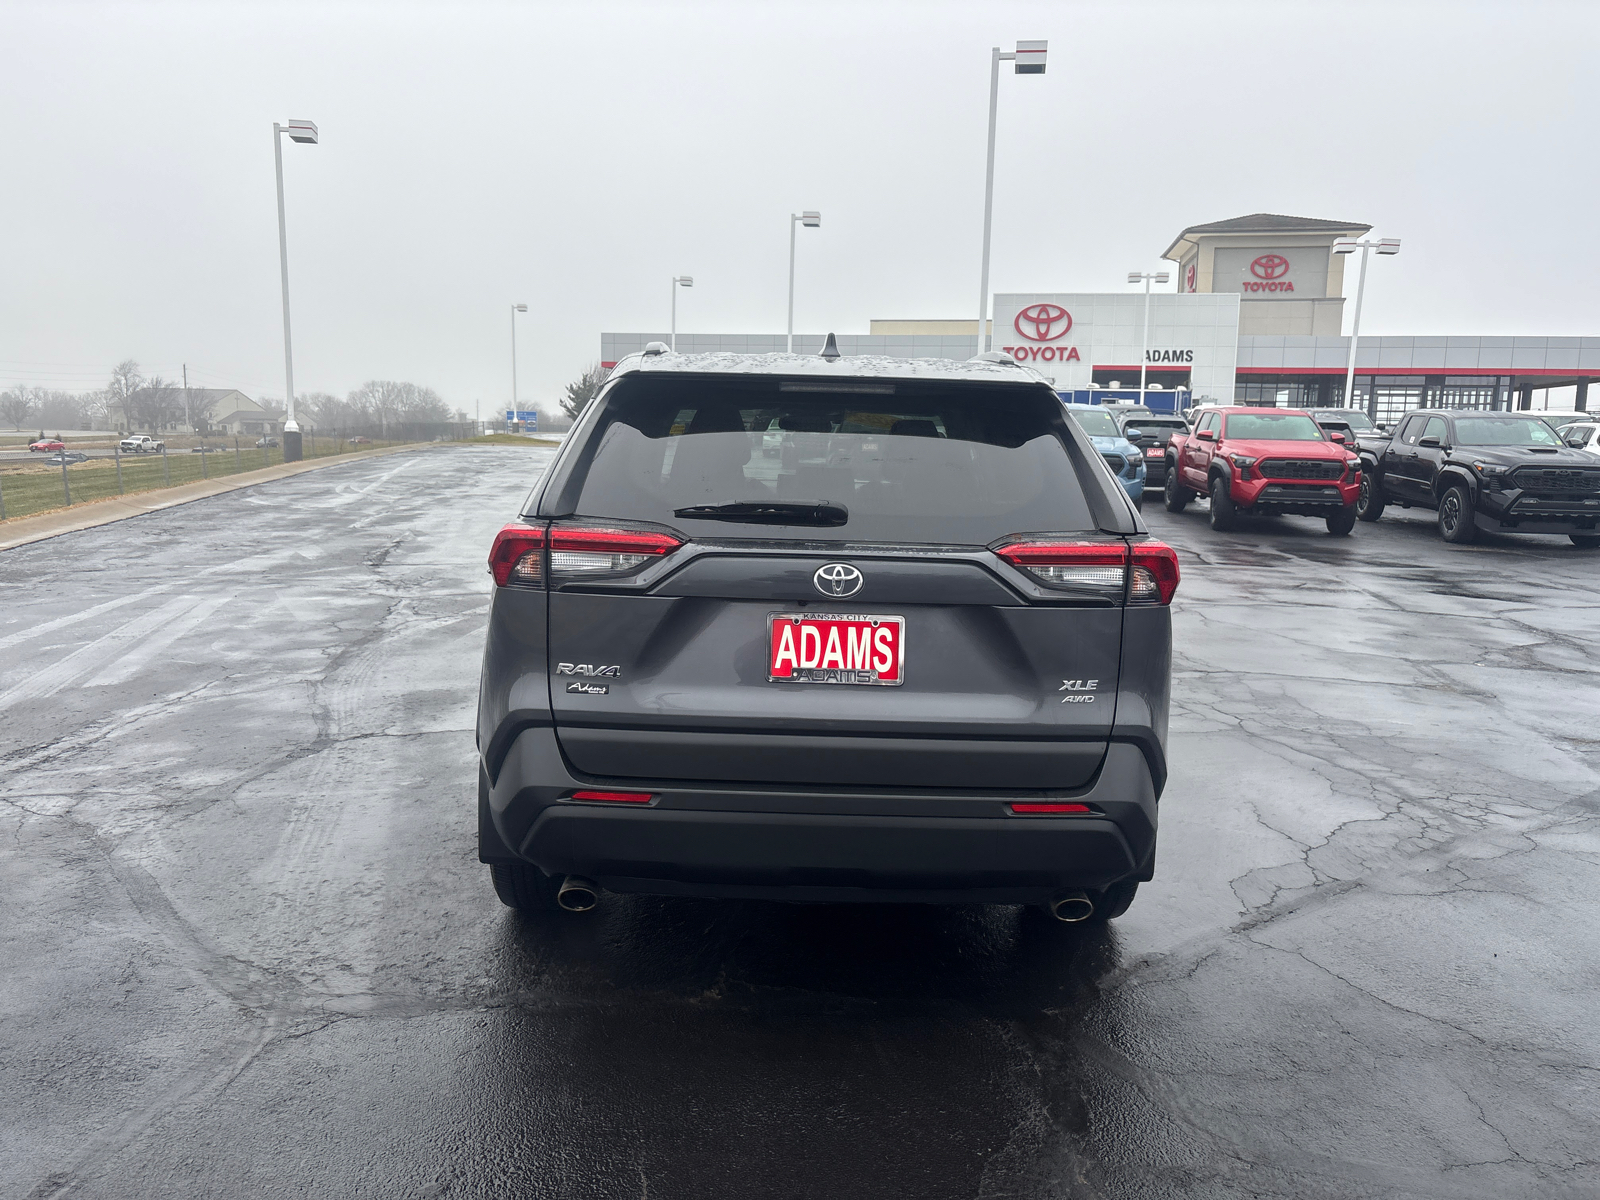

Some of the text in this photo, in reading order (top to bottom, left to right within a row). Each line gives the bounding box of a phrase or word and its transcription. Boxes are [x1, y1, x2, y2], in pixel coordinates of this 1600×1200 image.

[1242, 281, 1294, 292] TOYOTA
[1003, 346, 1080, 361] TOYOTA
[803, 613, 844, 621] KANSAS
[774, 624, 892, 673] ADAMS
[556, 662, 621, 679] RAV4
[1058, 679, 1099, 691] XLE
[1061, 695, 1095, 703] AWD
